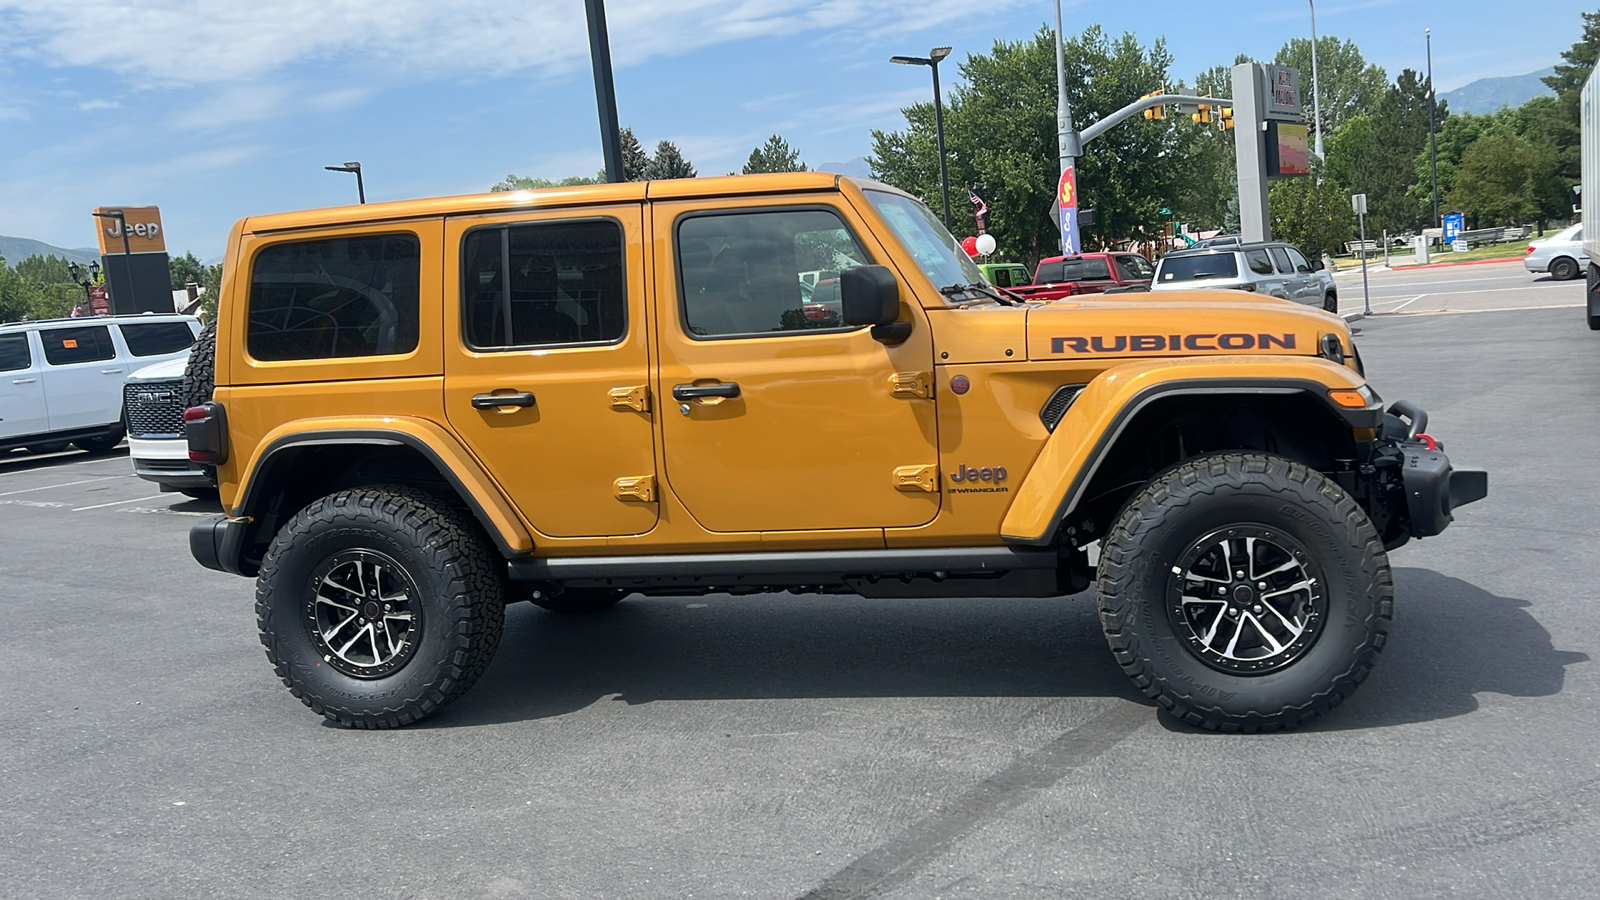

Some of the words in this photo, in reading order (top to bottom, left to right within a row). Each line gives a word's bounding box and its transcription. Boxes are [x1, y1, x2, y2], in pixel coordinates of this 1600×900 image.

[107, 220, 159, 239] Jeep
[1051, 333, 1297, 354] RUBICON
[950, 463, 1007, 484] Jeep
